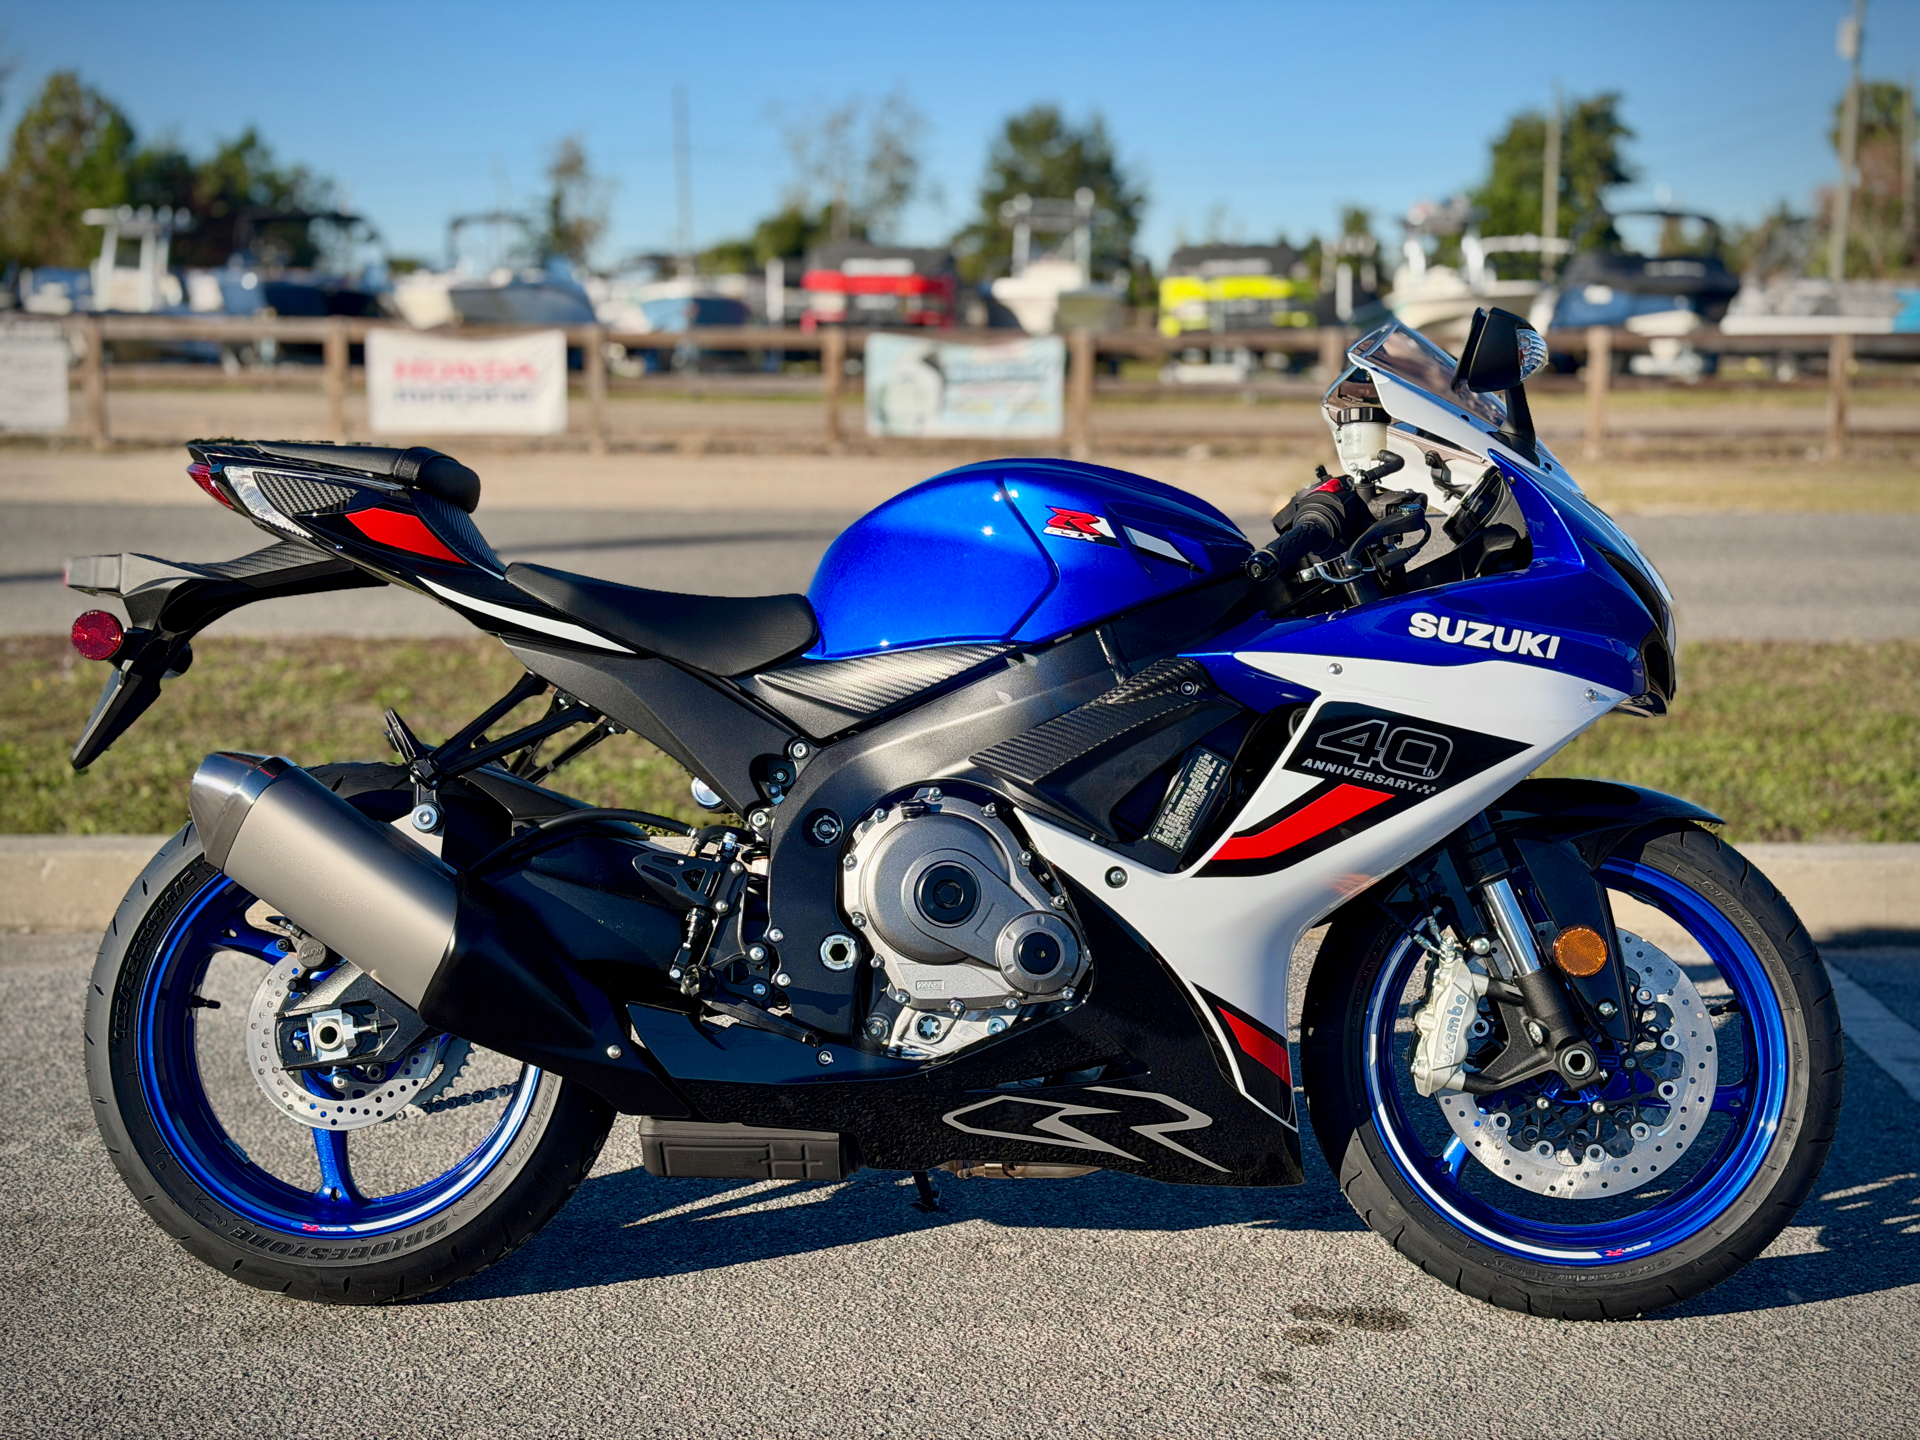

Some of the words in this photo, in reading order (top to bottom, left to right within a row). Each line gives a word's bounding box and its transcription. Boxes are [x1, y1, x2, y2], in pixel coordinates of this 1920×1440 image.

[1408, 612, 1561, 659] SUZUKI
[1315, 719, 1453, 780] 40
[1302, 758, 1418, 792] ANNIVERSARY
[1436, 994, 1467, 1065] brembo
[229, 1217, 450, 1263] BRIDGESTONE
